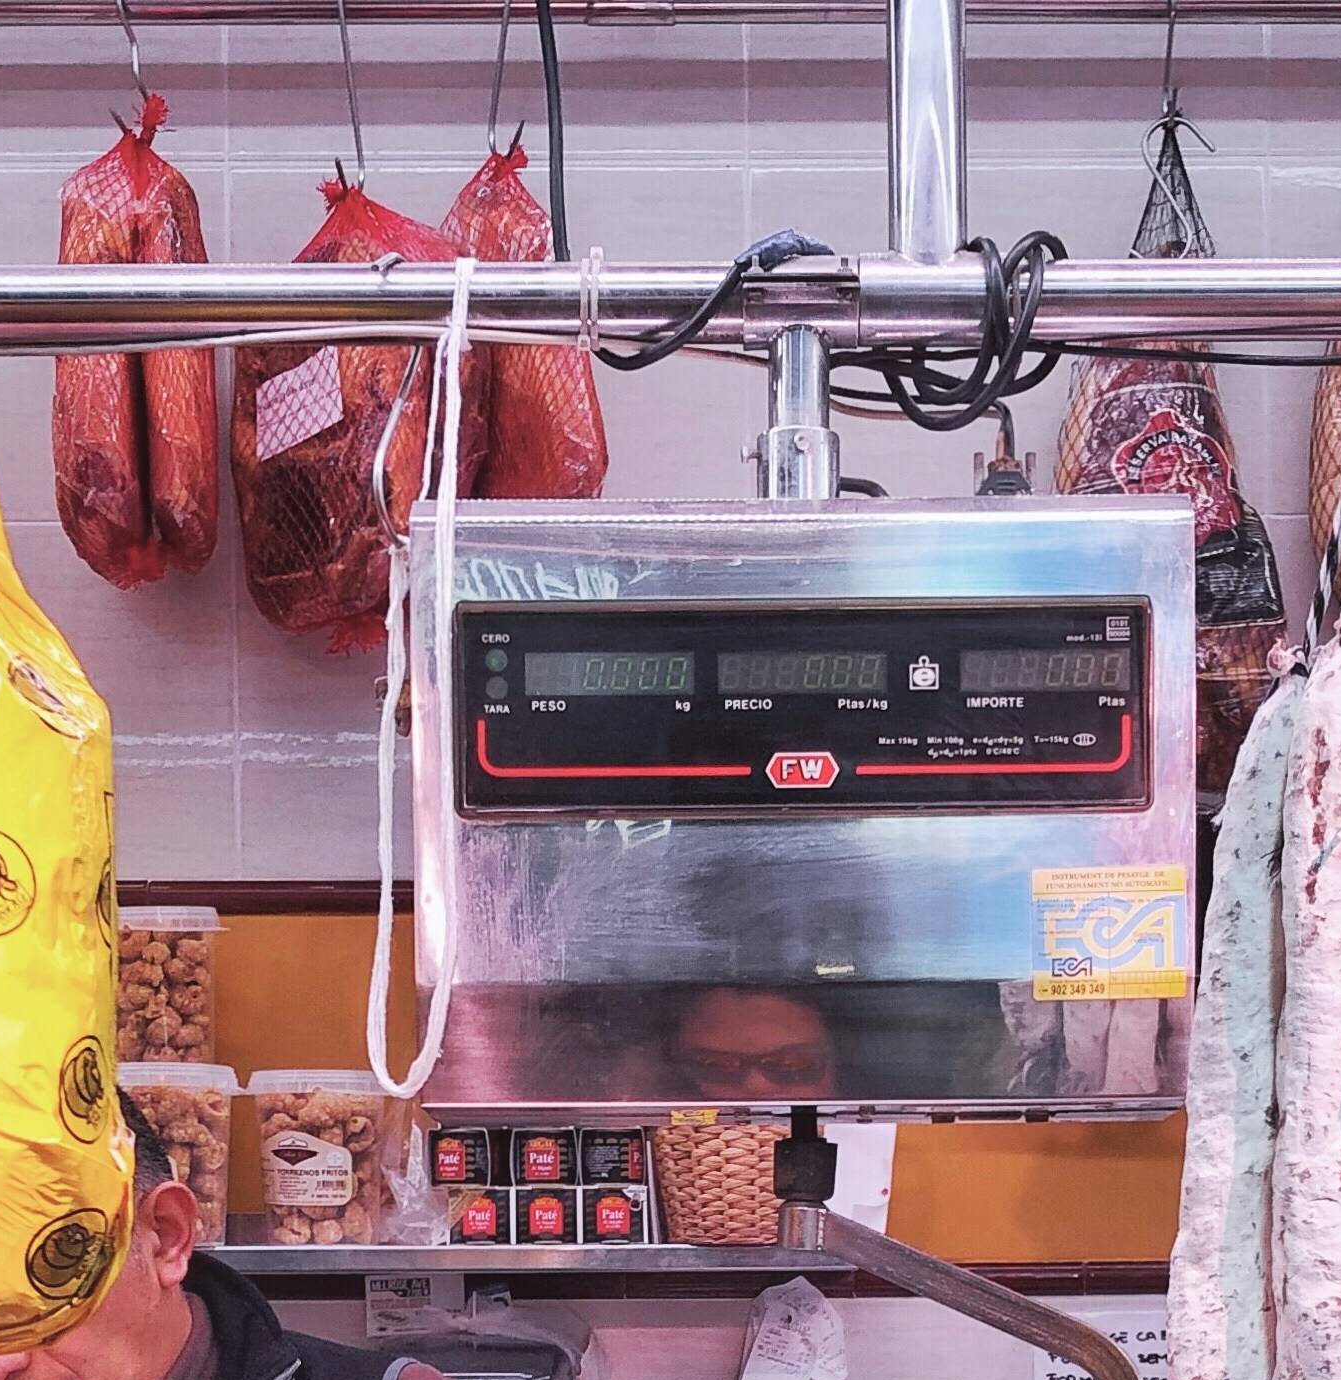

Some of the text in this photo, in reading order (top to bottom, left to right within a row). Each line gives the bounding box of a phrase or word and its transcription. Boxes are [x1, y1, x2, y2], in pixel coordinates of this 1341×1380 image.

[481, 633, 511, 645] CERO
[583, 656, 689, 691] 0.000
[530, 700, 691, 713] PESO kg
[724, 697, 889, 711] PRECIO Ptas/kg
[966, 695, 1127, 709] IMPORTE Ptas
[483, 704, 511, 714] TARA
[927, 736, 943, 745] Min
[780, 758, 824, 780] FW
[1051, 872, 1103, 880] INSTRUMENT
[1050, 983, 1106, 996] 902 349 349
[437, 1151, 461, 1165] Paté
[528, 1151, 556, 1165] Paté
[321, 1169, 349, 1177] FRITOS
[468, 1208, 492, 1221] Paté
[535, 1207, 559, 1221] Paté
[601, 1207, 626, 1220] Paté
